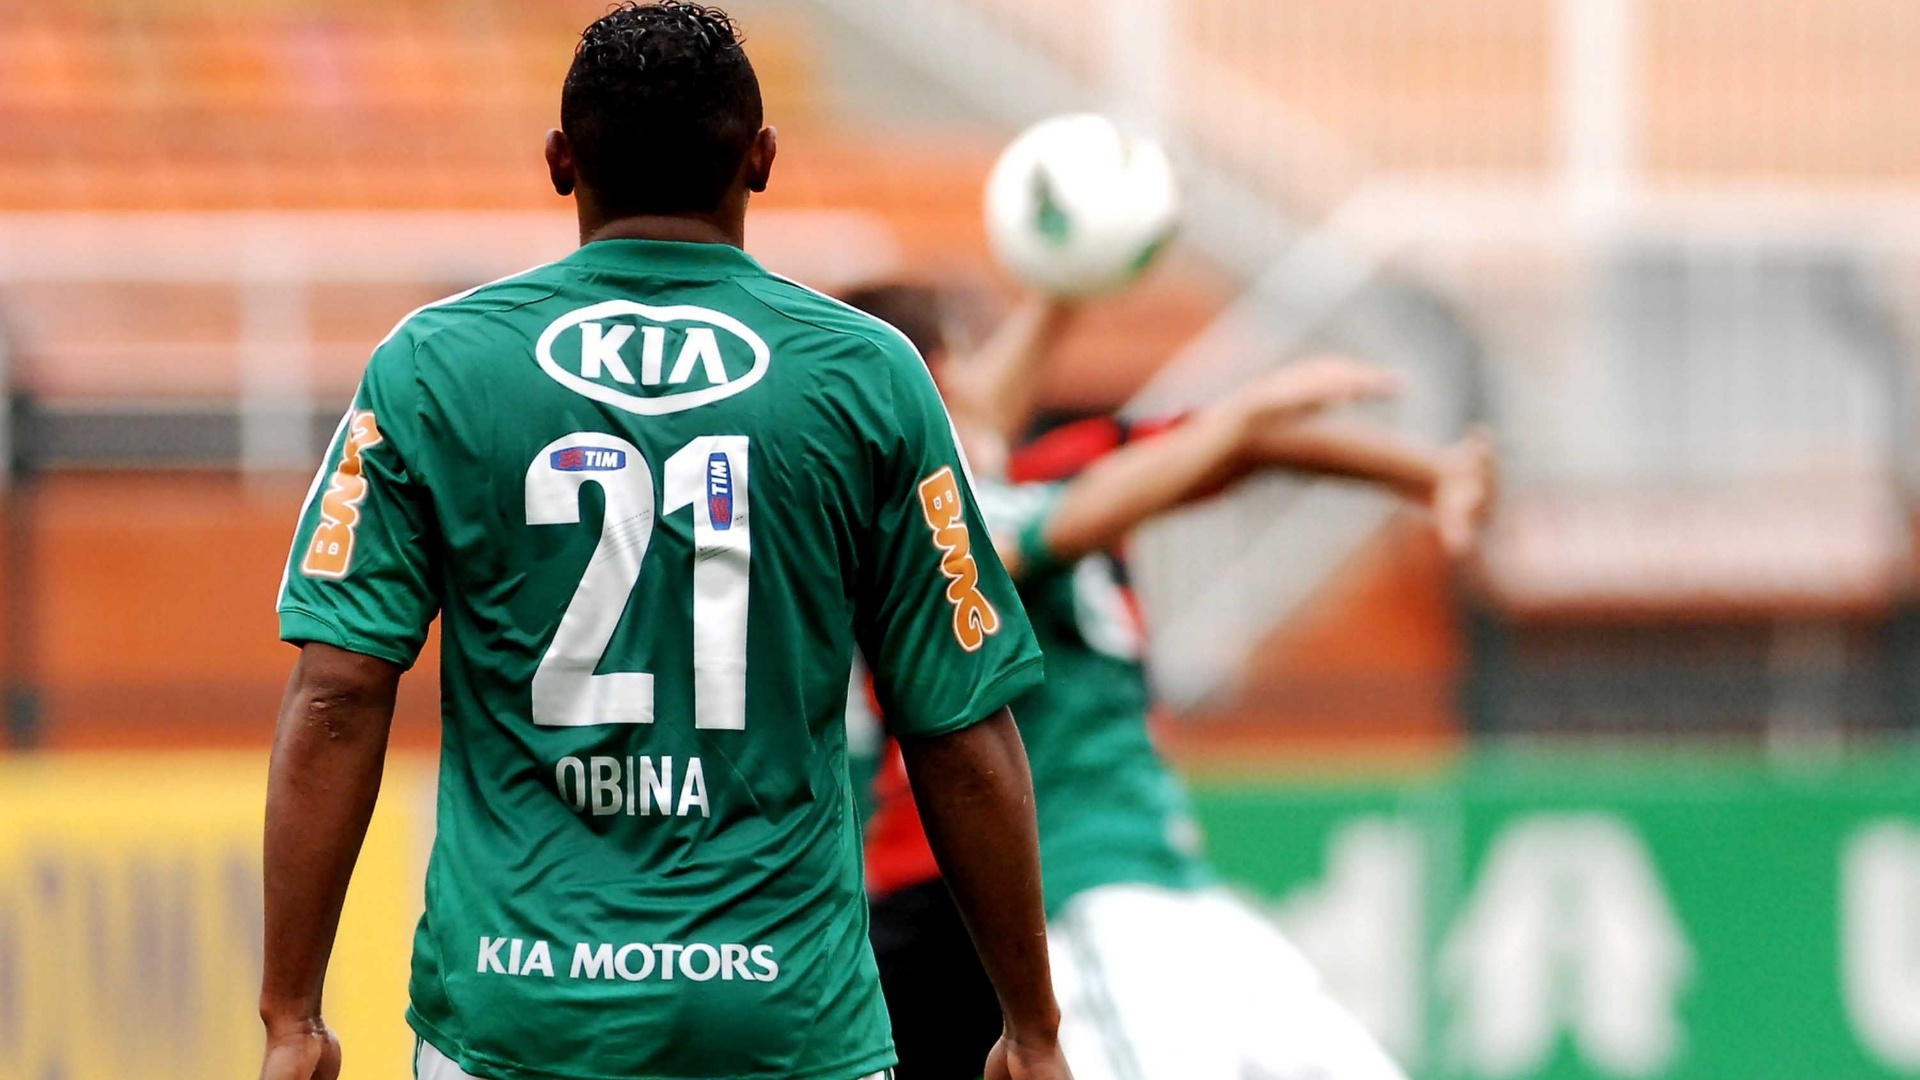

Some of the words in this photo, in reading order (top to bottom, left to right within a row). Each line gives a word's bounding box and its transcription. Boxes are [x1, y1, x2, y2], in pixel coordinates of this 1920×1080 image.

[579, 322, 728, 386] KIA
[585, 450, 618, 468] TIM
[710, 460, 727, 496] TIM
[525, 431, 751, 731] 21
[918, 465, 1000, 652] BMG
[555, 755, 711, 818] OBINA
[476, 936, 555, 977] KIA
[569, 942, 779, 982] MOTORS
